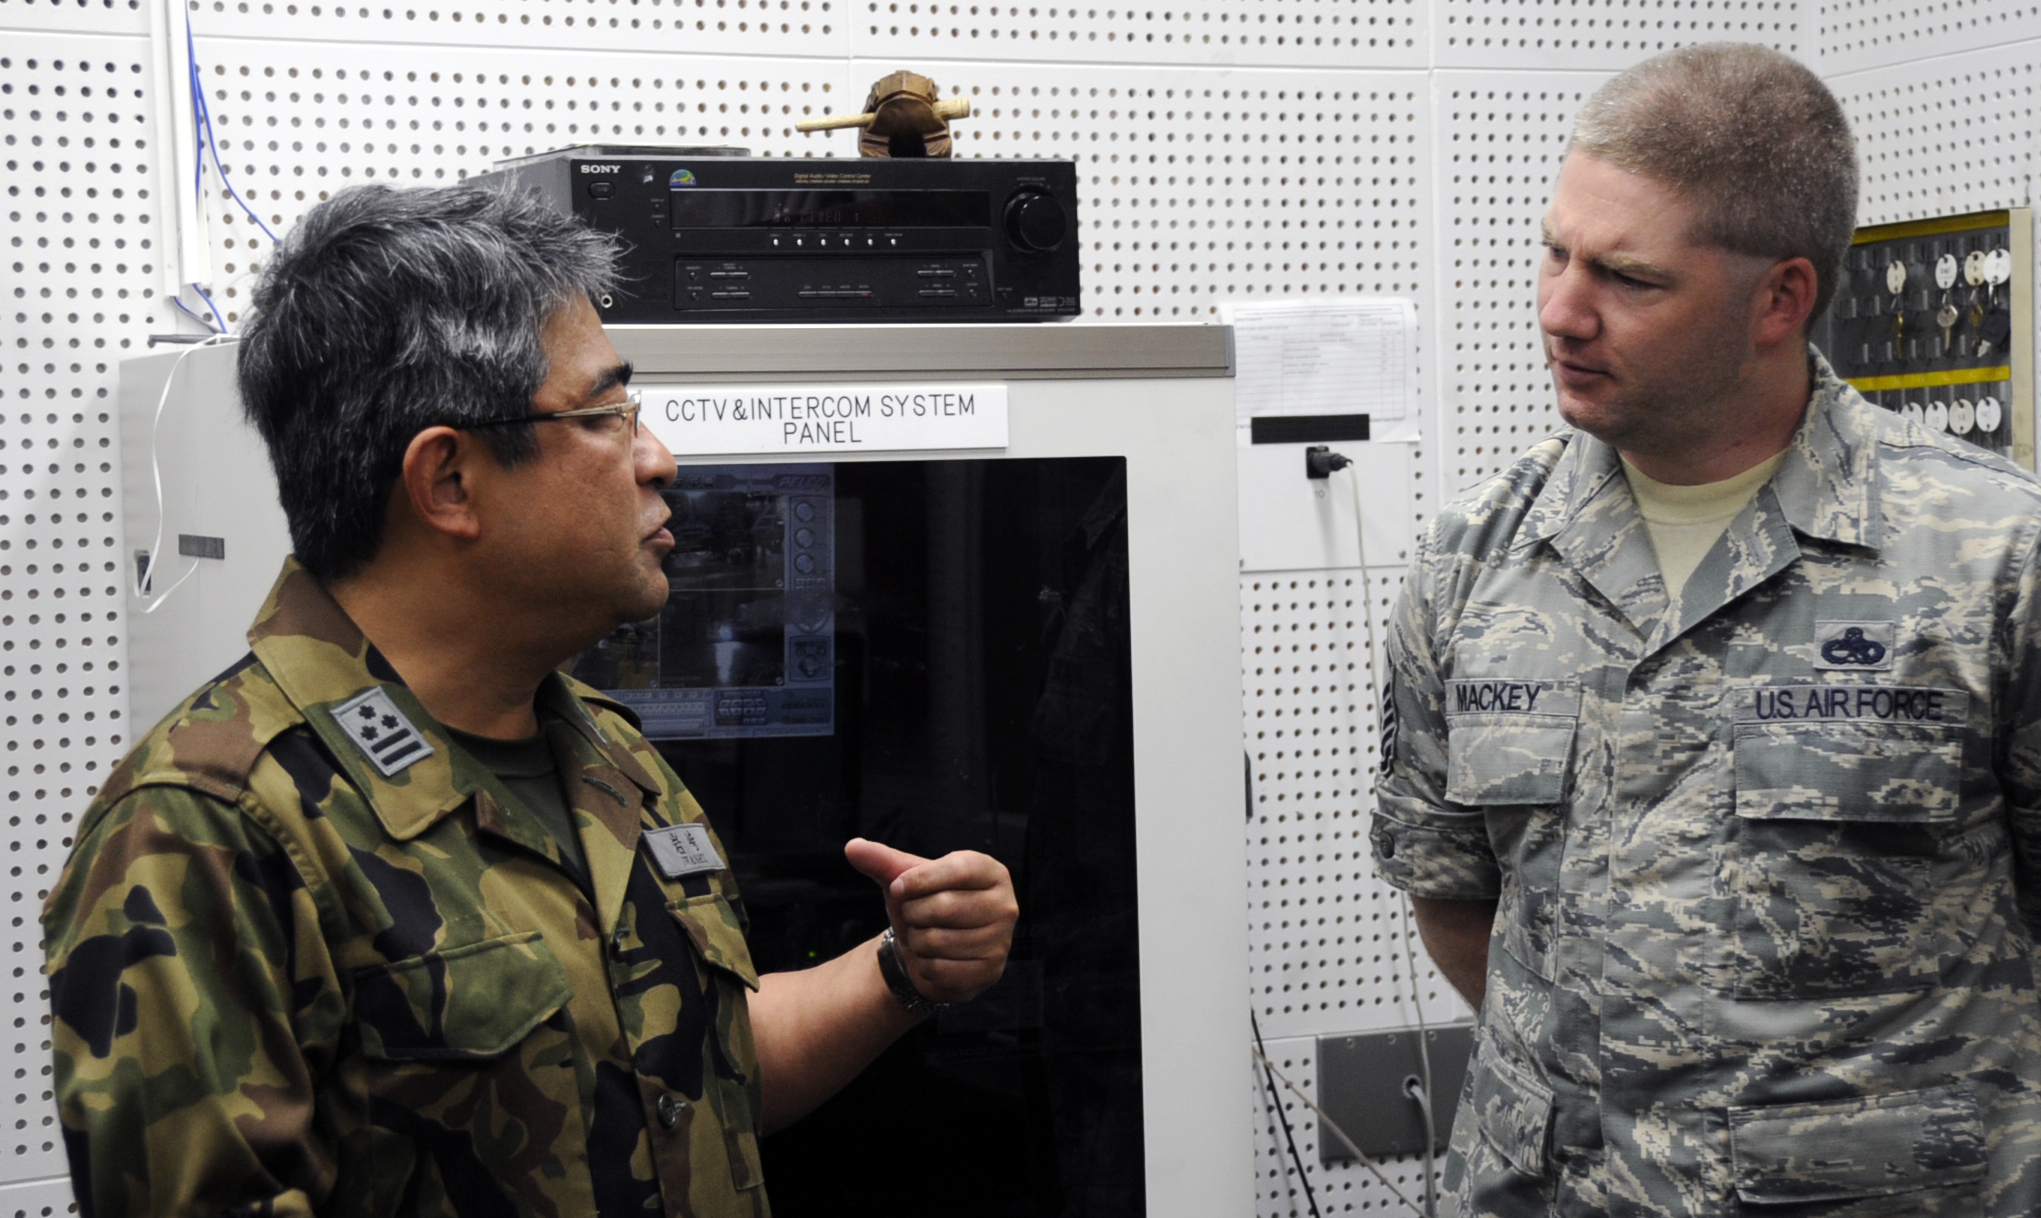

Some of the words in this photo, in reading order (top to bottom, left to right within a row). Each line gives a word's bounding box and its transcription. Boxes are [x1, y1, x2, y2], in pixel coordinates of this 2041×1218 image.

[580, 164, 622, 175] SONY
[881, 393, 976, 418] SYSTEM
[784, 421, 863, 445] PANEL
[1456, 683, 1541, 711] MACKEY
[1804, 689, 1850, 717] AIR
[1856, 689, 1943, 720] FORCE
